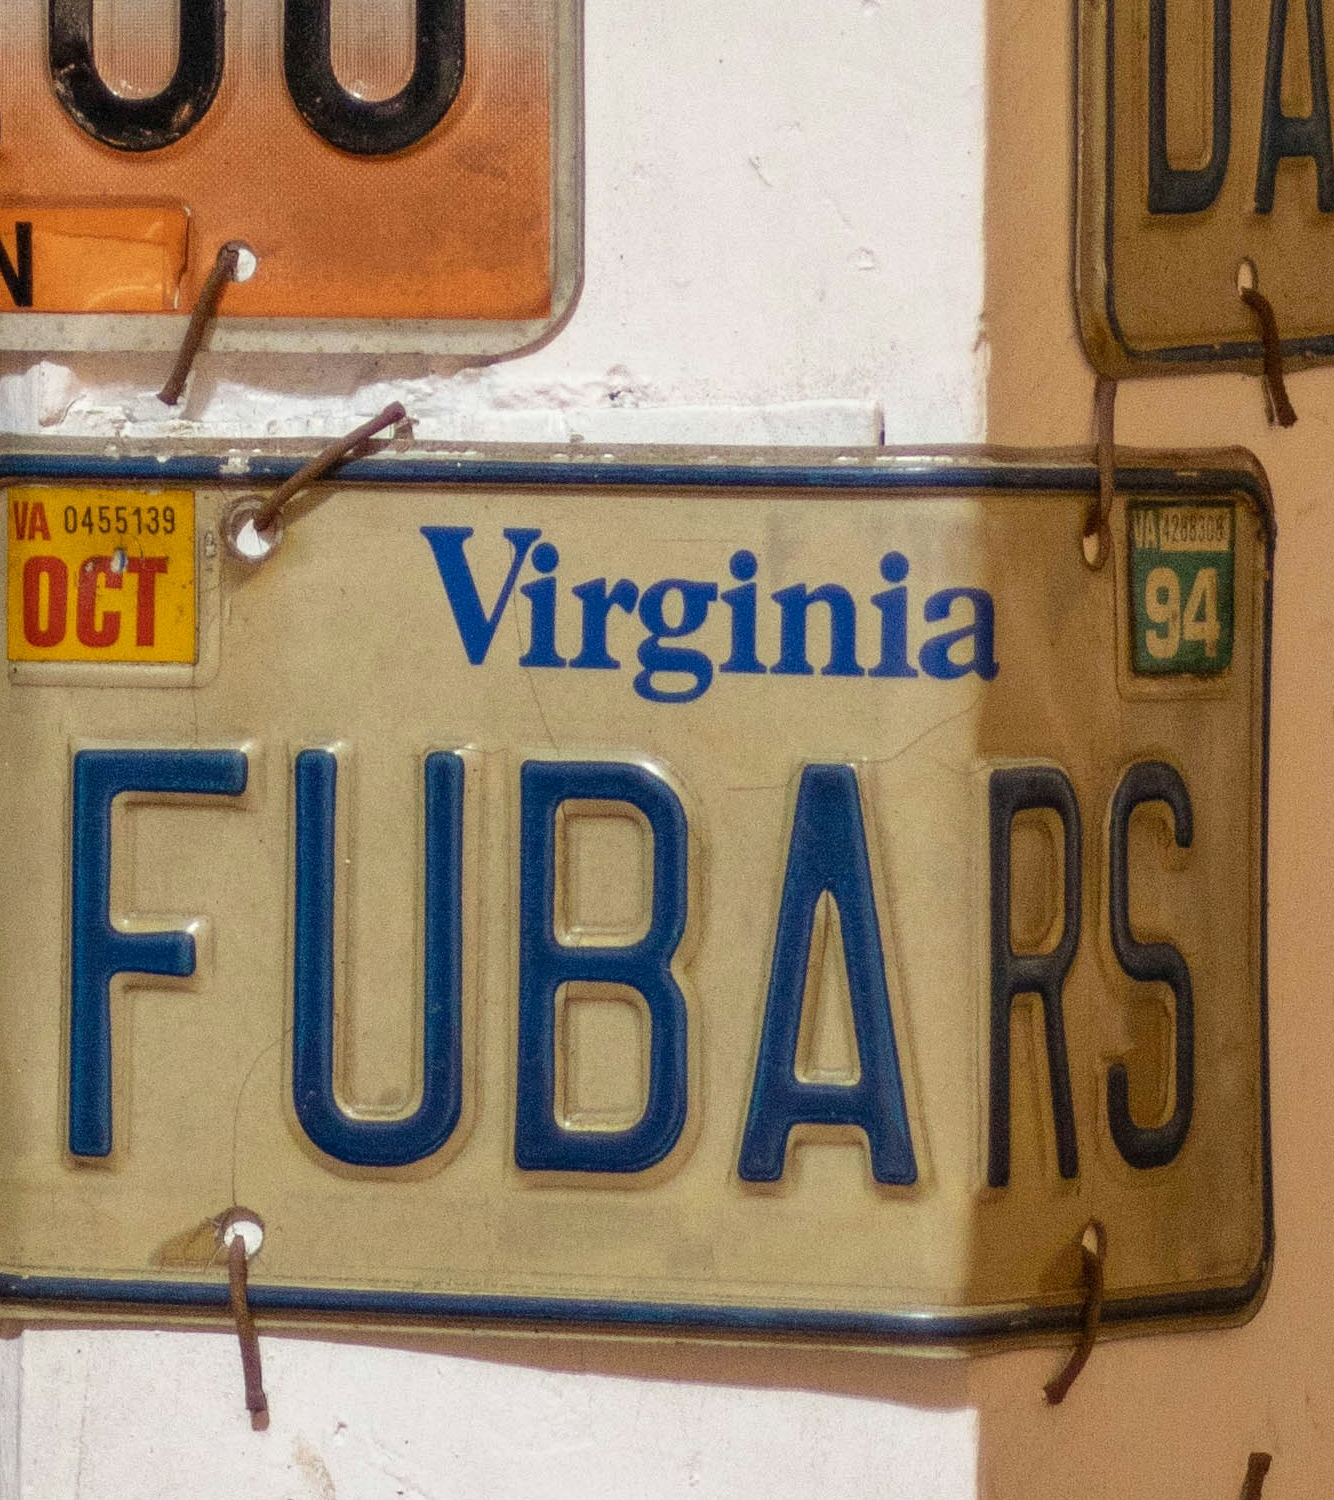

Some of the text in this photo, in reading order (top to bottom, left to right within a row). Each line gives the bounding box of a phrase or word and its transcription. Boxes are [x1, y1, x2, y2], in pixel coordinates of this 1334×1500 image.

[13, 500, 175, 541] VA 0455139
[22, 554, 169, 648] OCT
[420, 525, 1000, 704] Virginia
[1144, 566, 1221, 660] 94
[68, 747, 1194, 1189] FUBARS
